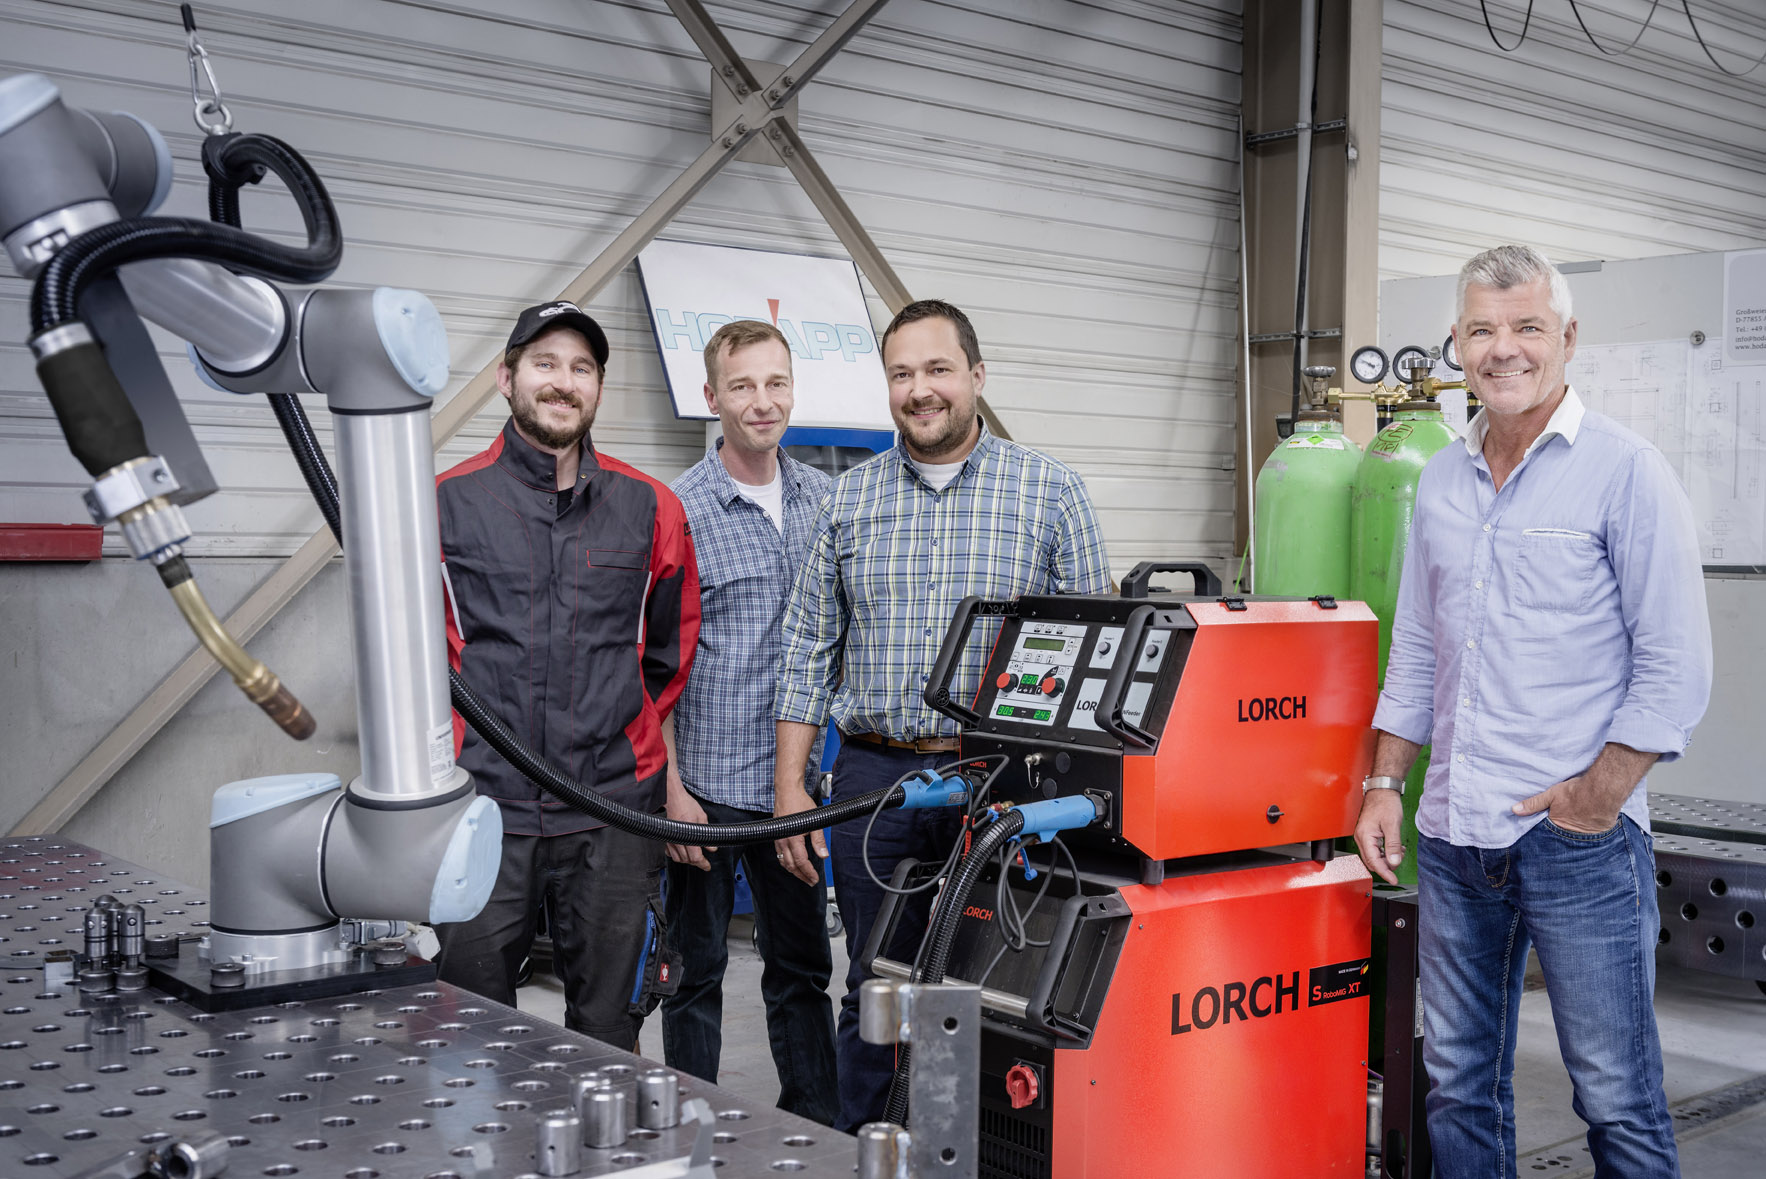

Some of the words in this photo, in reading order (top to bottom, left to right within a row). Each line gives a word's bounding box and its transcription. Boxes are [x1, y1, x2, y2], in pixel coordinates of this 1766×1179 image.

[656, 308, 873, 362] HOAPP
[1076, 700, 1098, 712] LOR
[1238, 695, 1307, 723] LORCH
[963, 905, 993, 921] ORCH
[1170, 970, 1300, 1036] LORCH
[1312, 985, 1322, 1001] S
[1348, 981, 1361, 995] XT
